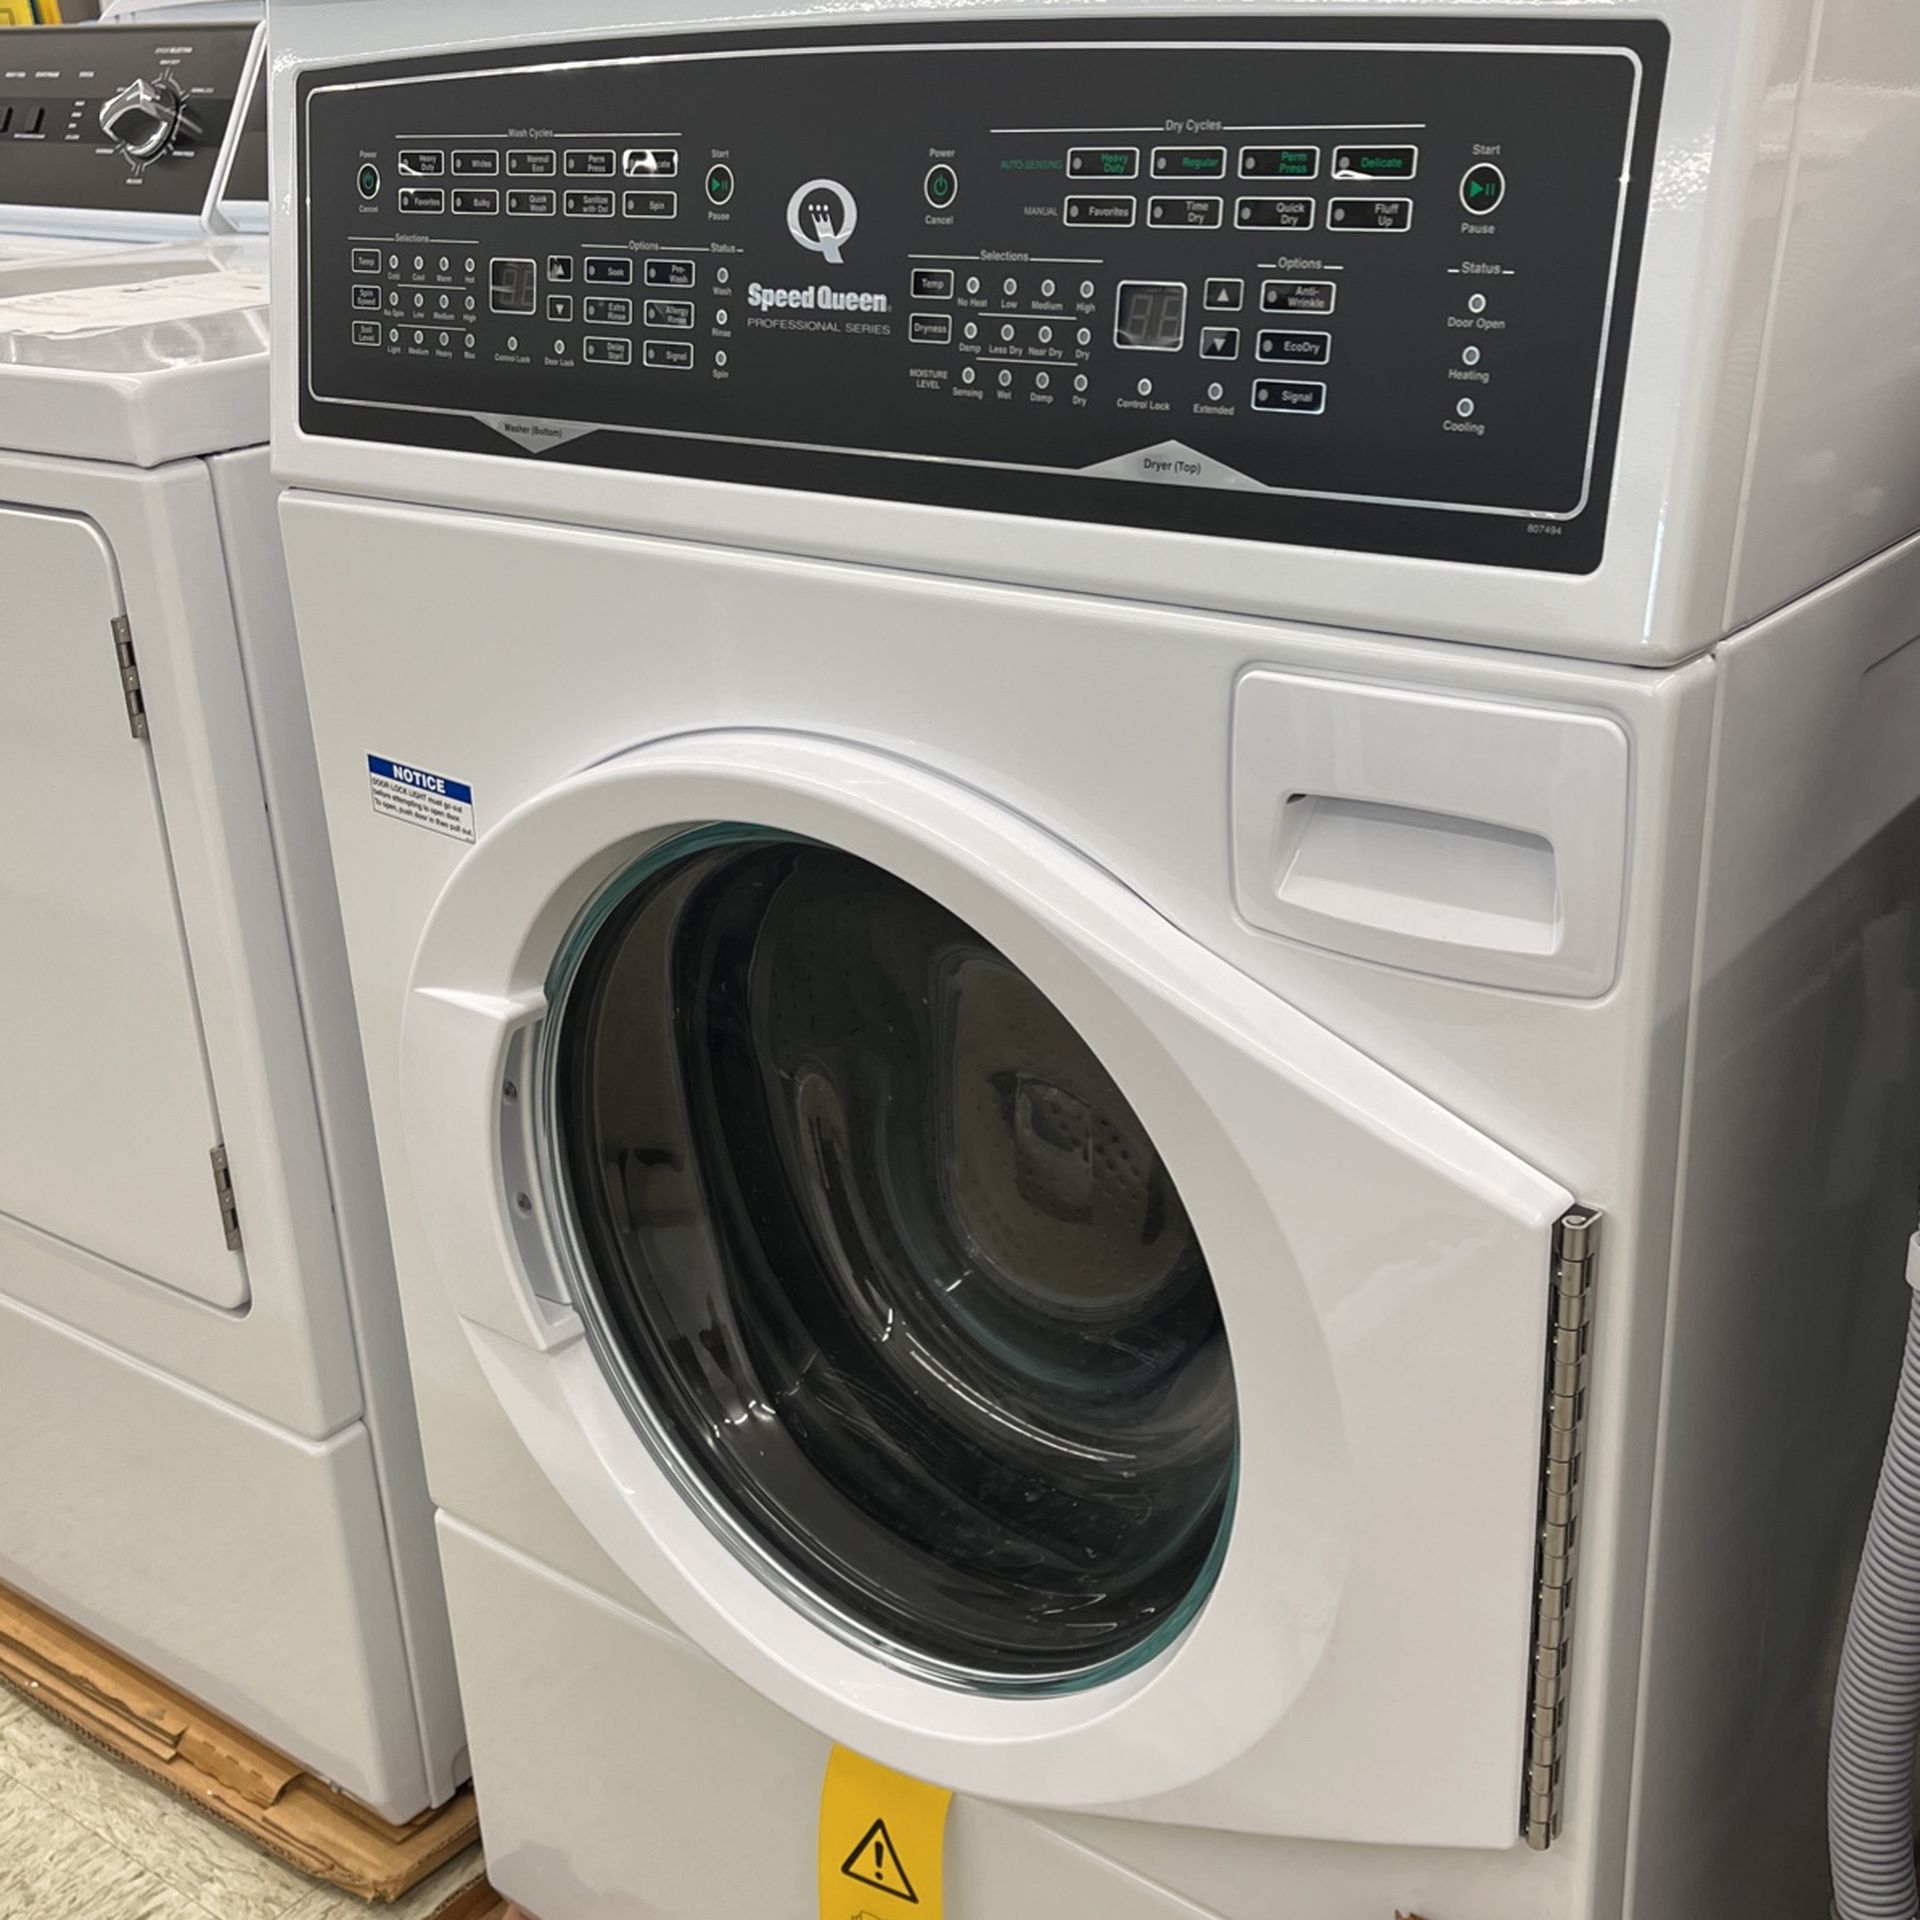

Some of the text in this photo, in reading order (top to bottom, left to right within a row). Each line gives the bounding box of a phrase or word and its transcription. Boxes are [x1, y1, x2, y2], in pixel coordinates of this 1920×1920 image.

[1166, 119, 1222, 133] Dry Cycles
[507, 127, 553, 139] Wash Cycles
[359, 150, 377, 159] Power
[712, 149, 729, 158] Start
[929, 148, 955, 158] Power
[1472, 144, 1500, 156] Start
[419, 155, 436, 164] Heavy
[527, 154, 549, 163] Normal
[588, 155, 605, 163] Perm
[1101, 153, 1129, 164] Heavy
[1281, 151, 1308, 161] Perm
[421, 163, 435, 172] Duty
[471, 160, 492, 168] Whites
[1182, 157, 1219, 170] Regular
[1360, 157, 1403, 168] Delicate
[532, 164, 544, 172] Eco
[587, 164, 605, 173] Press
[1104, 163, 1126, 174] Duty
[1279, 163, 1308, 173] Press
[415, 197, 440, 206] Favorites
[473, 199, 490, 208] Bulky
[529, 194, 547, 203] Quick
[583, 195, 608, 204] Sanitize
[359, 205, 378, 213] Cancel
[530, 204, 547, 213] Wash
[649, 201, 665, 211] Spin
[1023, 206, 1058, 216] MANUAL
[1186, 201, 1209, 211] Time
[1276, 202, 1305, 213] Quick
[1374, 203, 1399, 214] Fluff
[708, 212, 730, 221] Pause
[1088, 206, 1129, 217] Favorites
[925, 214, 954, 225] Cancel
[1188, 212, 1205, 225] Dry
[1280, 214, 1298, 227] Dry
[1378, 215, 1393, 227] Up
[1460, 222, 1495, 234] Pause
[395, 233, 430, 243] Selections
[629, 240, 660, 250] Options
[710, 243, 736, 253] Status
[980, 250, 1029, 262] Selections
[358, 257, 374, 267] Temp
[1278, 257, 1322, 271] Options
[608, 268, 625, 277] Soak
[1461, 261, 1501, 275] Status
[412, 273, 425, 281] Cool
[464, 276, 475, 284] Hot
[669, 274, 688, 283] Wash
[922, 278, 945, 290] Temp
[360, 289, 373, 298] Spin
[712, 287, 732, 296] Wash
[1295, 286, 1320, 297] Anti-
[357, 297, 376, 306] Speed
[748, 283, 815, 311] Speed
[608, 303, 626, 312] Extra
[957, 297, 988, 308] No Heat
[1001, 300, 1018, 310] Low
[1031, 301, 1063, 311] Medium
[1287, 297, 1325, 309] Wrinkle
[665, 306, 689, 317] Allergy
[1076, 302, 1096, 314] High
[413, 311, 425, 319] Low
[433, 312, 455, 320] Medium
[463, 313, 476, 323] High
[607, 313, 626, 321] Rinse
[667, 316, 687, 325] Rinse
[1447, 316, 1506, 330] Door Open
[361, 325, 373, 334] Soil
[747, 317, 891, 336] PROFESSIONAL SERIES
[914, 323, 947, 335] Dryness
[712, 328, 731, 337] Rinse
[358, 334, 375, 342] Level
[387, 345, 401, 354] Light
[607, 342, 625, 351] Delay
[959, 343, 982, 354] Damp
[989, 344, 1023, 358] Less Dry
[1283, 341, 1321, 355] EcoDry
[408, 348, 429, 356] Medium
[435, 350, 452, 358] Heavy
[608, 351, 625, 360] Start
[666, 351, 687, 362] Signal
[1028, 346, 1063, 359] Near Dry
[1075, 349, 1091, 361] Dry
[494, 353, 530, 363] Control Lock
[544, 357, 575, 367] Door Lock
[712, 369, 729, 379] Spin
[909, 369, 948, 379] MOISTURE
[1448, 369, 1490, 384] Heating
[916, 379, 941, 390] LEVEL
[953, 387, 983, 400] Sensing
[997, 390, 1012, 400] Wet
[1030, 392, 1053, 404] Damp
[1281, 390, 1313, 404] Signal
[1072, 395, 1087, 407] Dry
[1117, 398, 1170, 411] Control Lock
[1193, 403, 1235, 416] Extended
[504, 423, 562, 439] Washer (Bottom)
[1443, 420, 1485, 436] Cooling
[1144, 457, 1202, 475] Dryer (Top)
[1527, 523, 1562, 536] 807494
[392, 764, 446, 793] NOTICE
